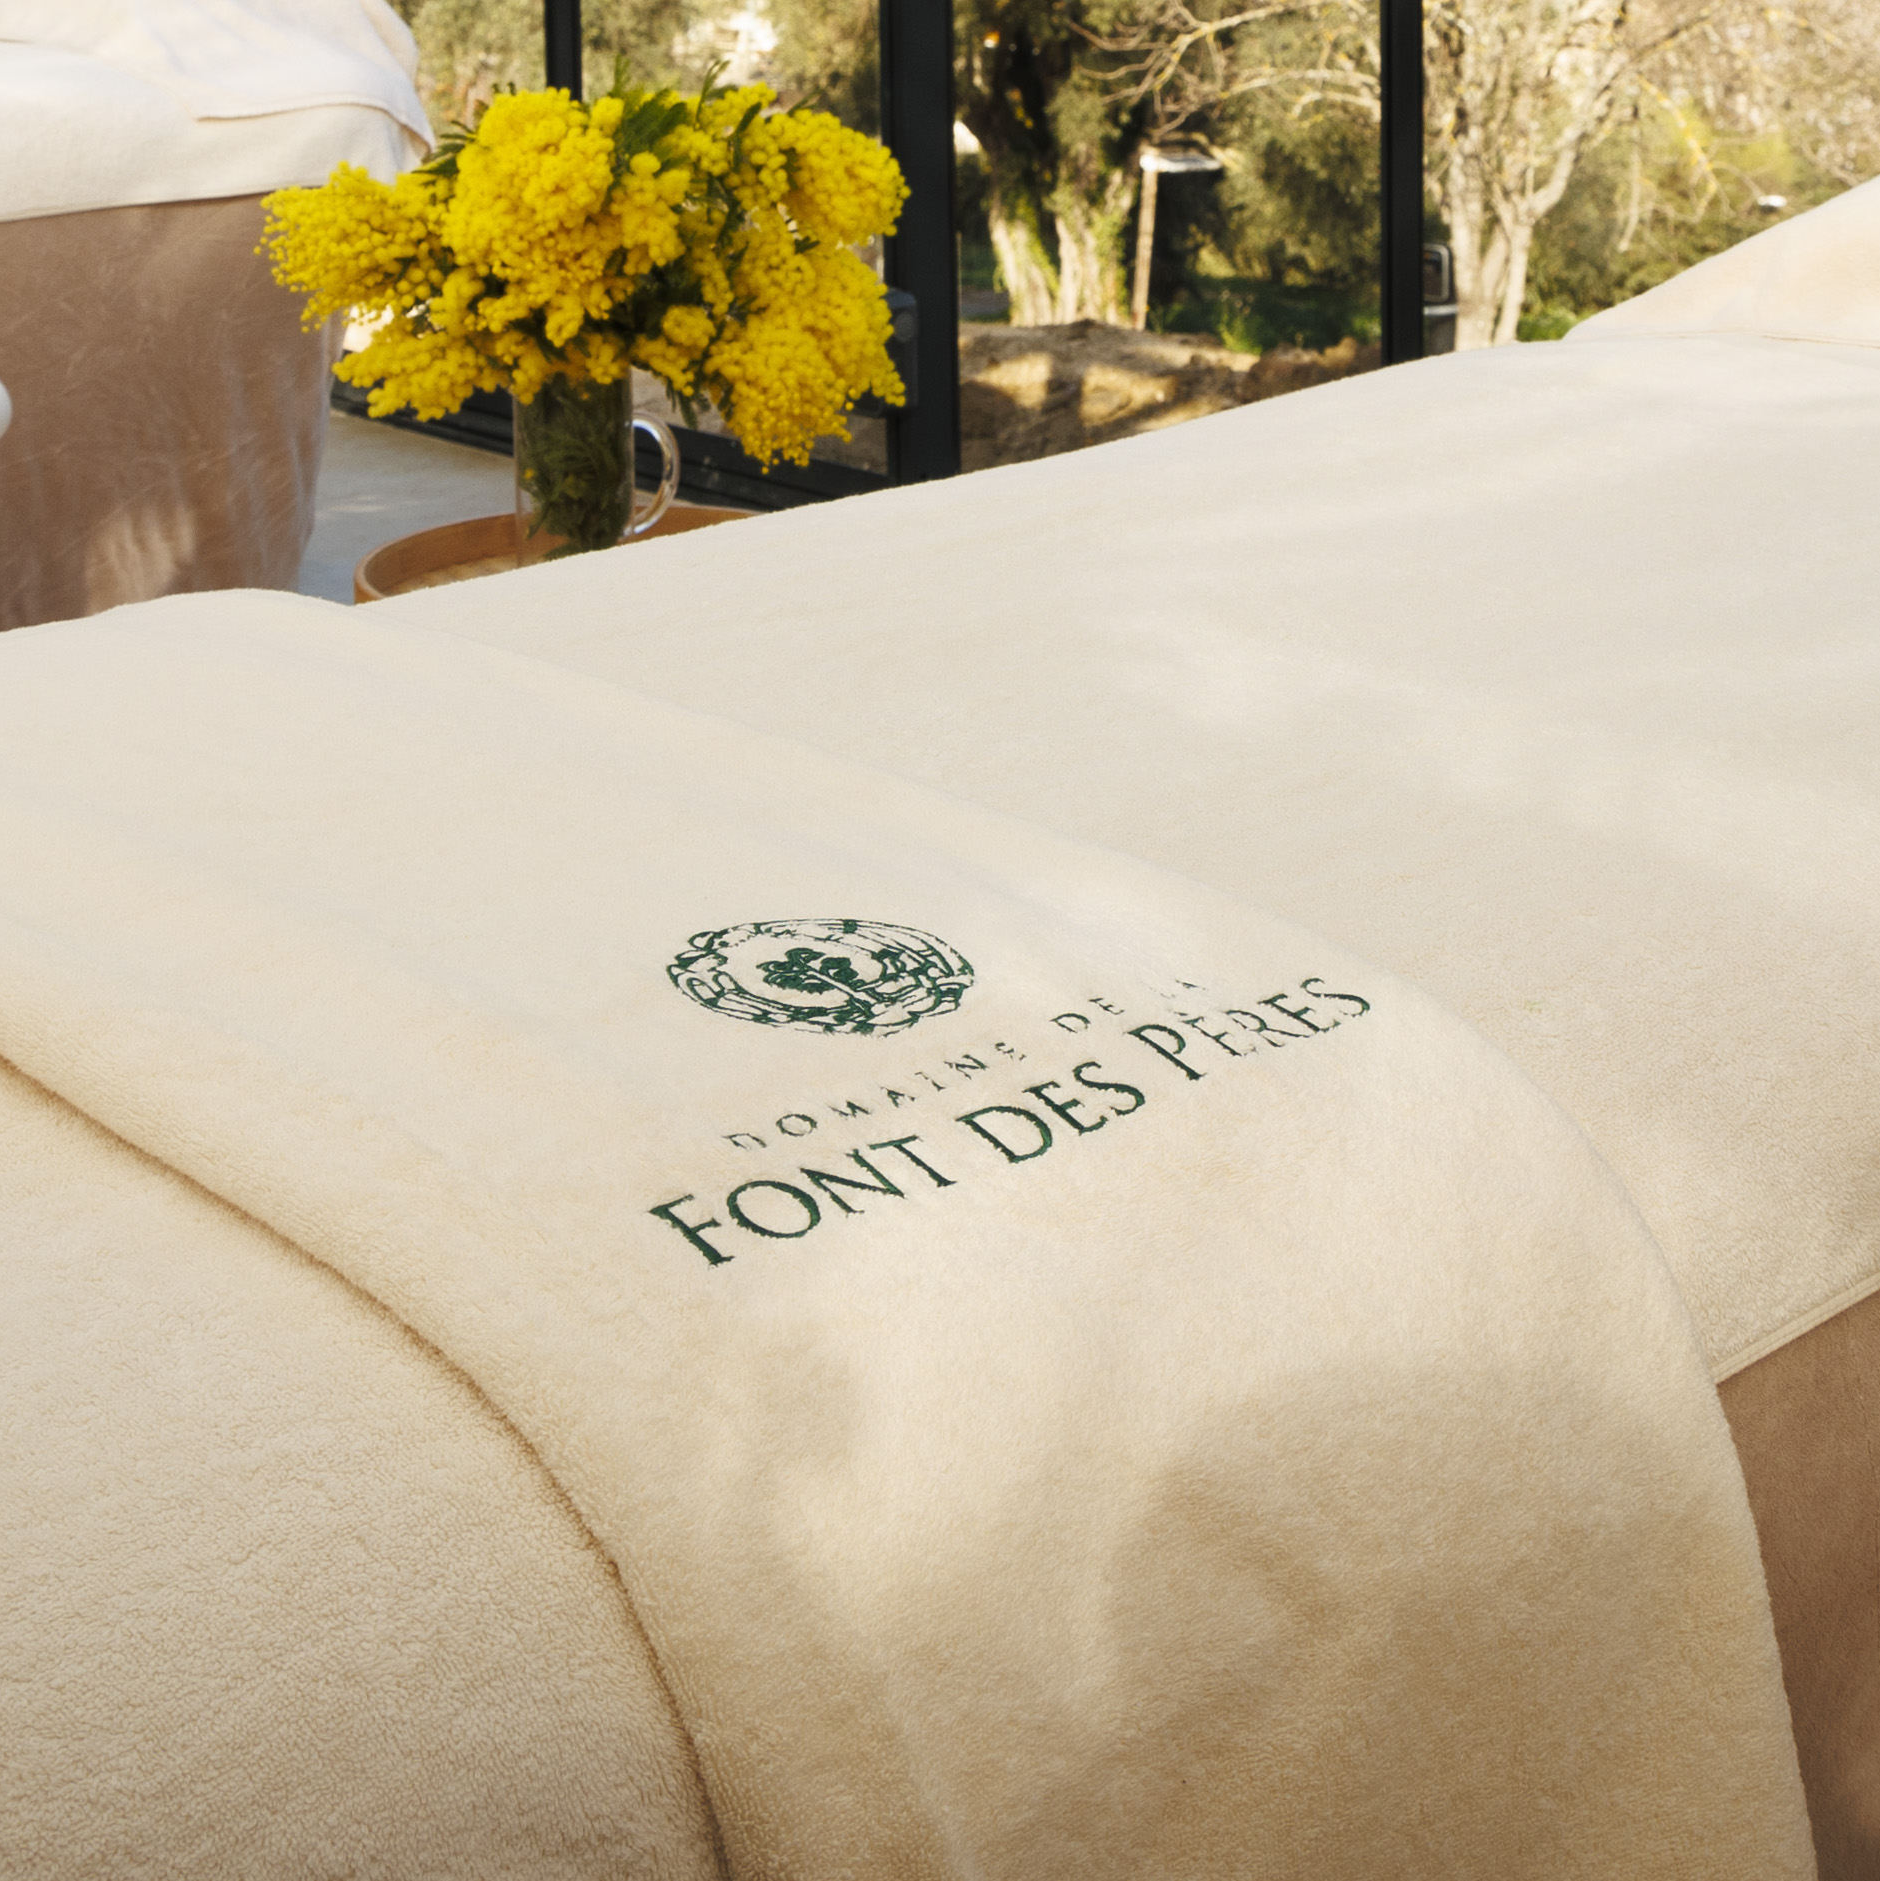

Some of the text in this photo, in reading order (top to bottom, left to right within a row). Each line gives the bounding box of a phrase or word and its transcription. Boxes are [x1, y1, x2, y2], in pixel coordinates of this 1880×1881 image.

[1049, 996, 1125, 1034] DE
[647, 1133, 958, 1269] FONT
[953, 1060, 1147, 1164] DES
